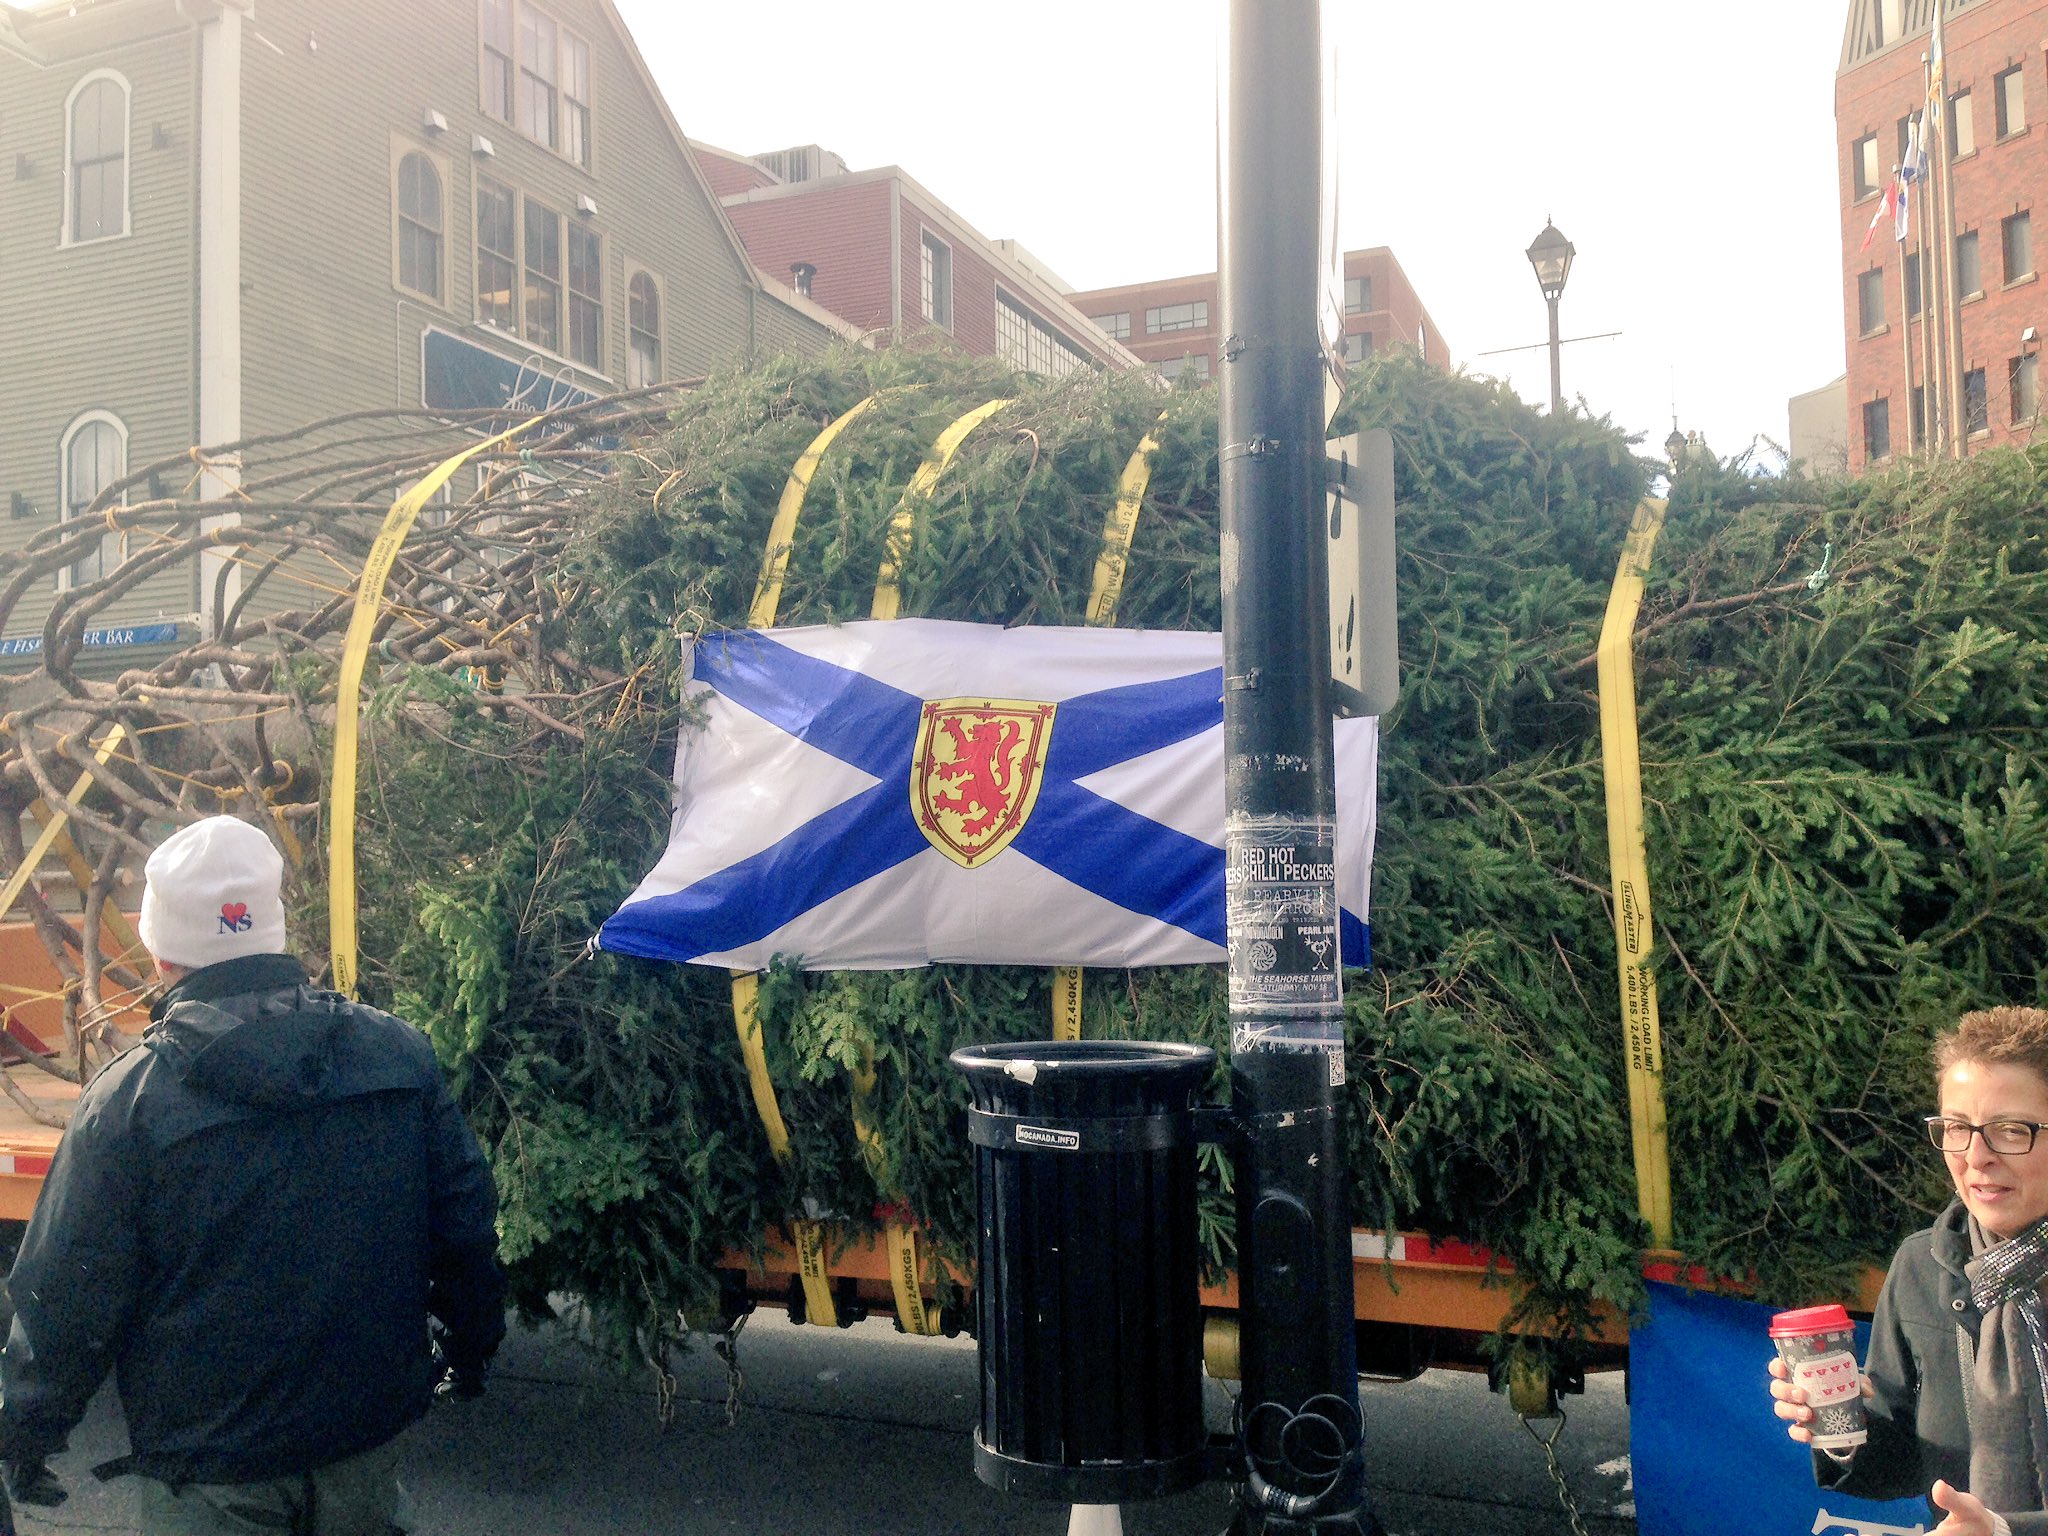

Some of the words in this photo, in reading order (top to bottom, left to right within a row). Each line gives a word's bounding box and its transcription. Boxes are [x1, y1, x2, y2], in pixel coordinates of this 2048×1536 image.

[106, 629, 134, 645] BAR
[1241, 847, 1266, 865] RED
[1268, 847, 1296, 864] HOT
[1241, 864, 1280, 881] CHILLI
[1284, 863, 1334, 881] PECKERS
[1624, 884, 1637, 950] SLINGMASTER
[1297, 926, 1321, 935] PEARL
[1249, 975, 1262, 983] THE
[1264, 975, 1308, 983] SEAHORSE
[1310, 974, 1335, 983] TAVERN
[1302, 983, 1319, 991] NOV
[1627, 965, 1635, 991] 5,400
[1639, 967, 1649, 1015] WORKING
[1630, 1025, 1640, 1053] 2,450
[1641, 1017, 1651, 1045] LOAD
[1633, 1055, 1642, 1070] KG
[1644, 1047, 1654, 1072] LIMIT
[902, 1248, 917, 1299] 2,450KGS
